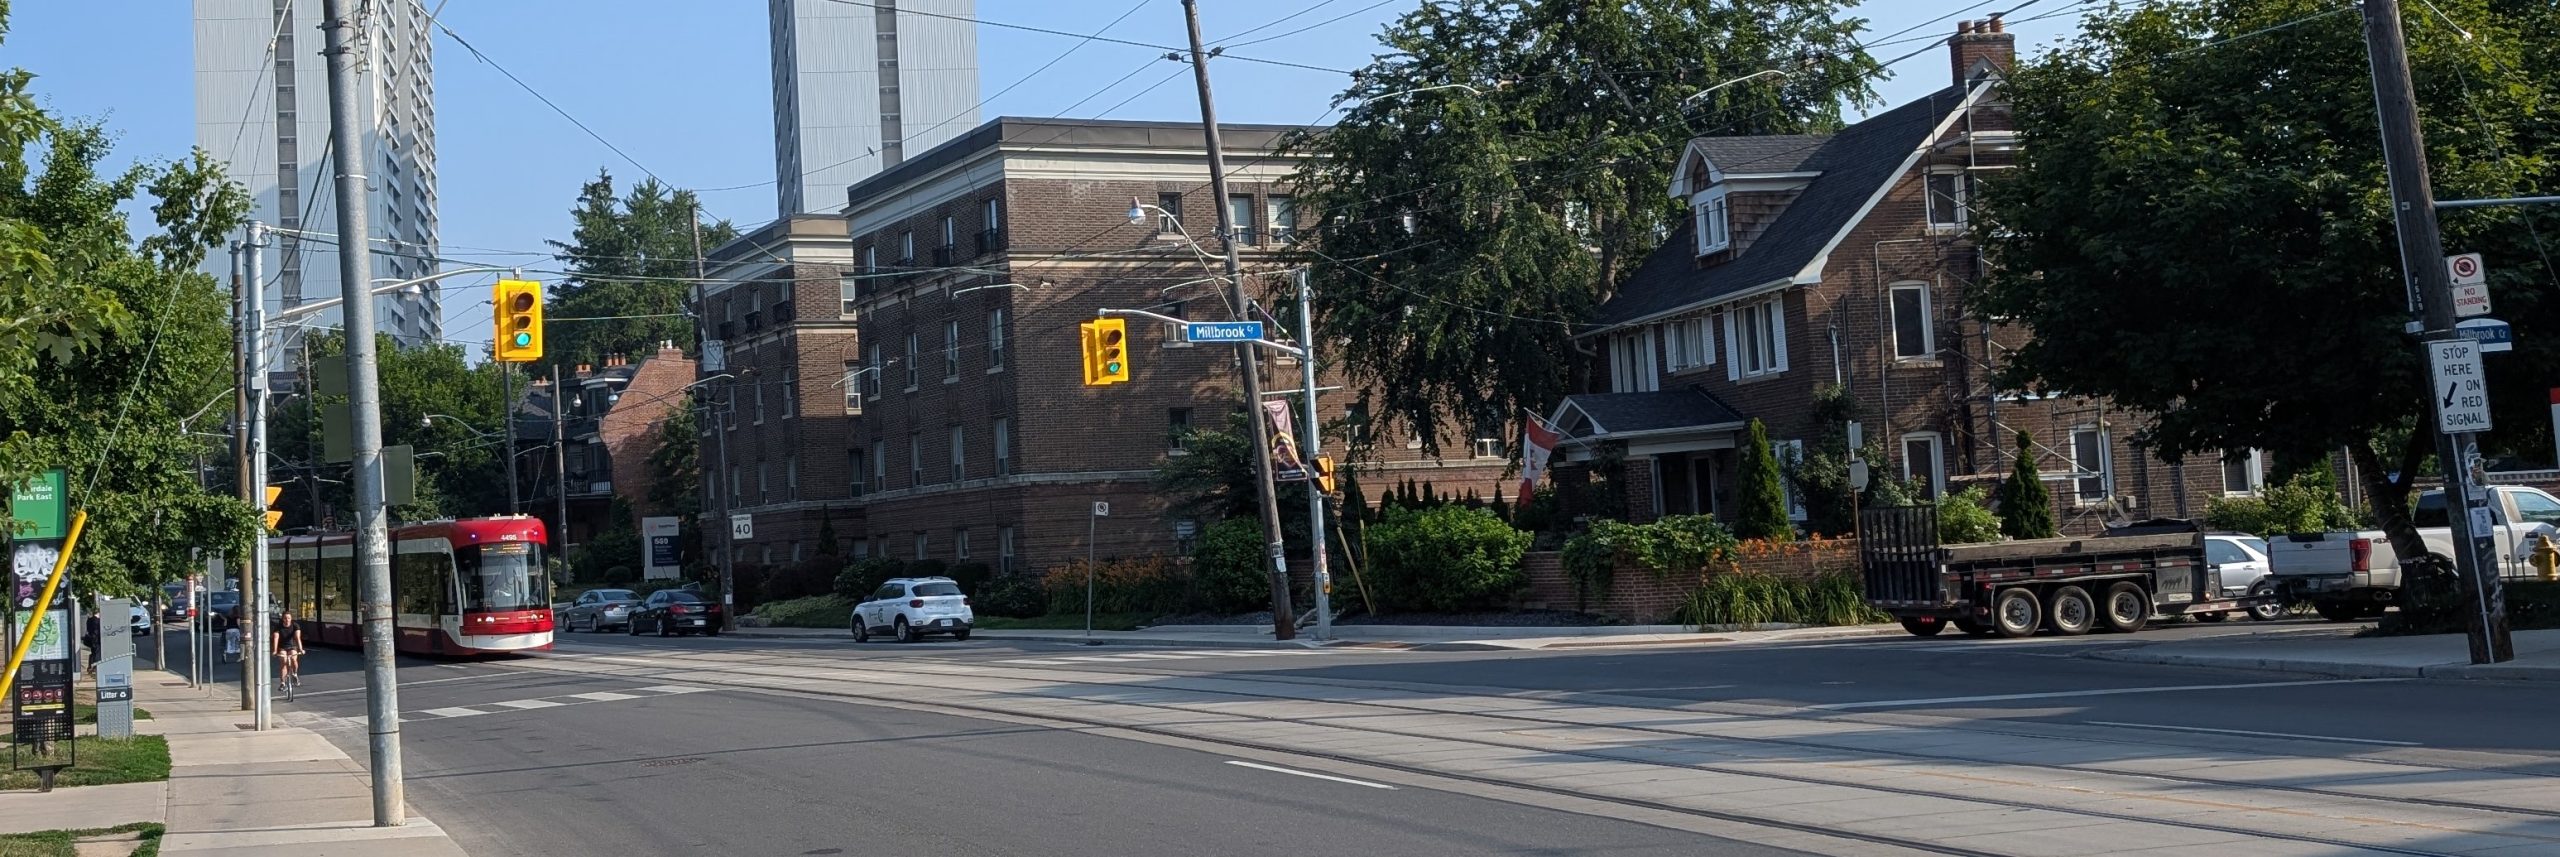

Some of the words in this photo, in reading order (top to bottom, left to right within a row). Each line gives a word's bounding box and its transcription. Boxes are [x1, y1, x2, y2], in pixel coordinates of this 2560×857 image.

[2464, 288, 2476, 297] NO
[2456, 296, 2488, 307] STANDING
[1196, 326, 1246, 339] Millbrook
[1246, 325, 1254, 334] Cr
[2459, 328, 2496, 340] Millbrook
[2498, 330, 2507, 339] Cr
[2442, 347, 2469, 360] STOP
[2443, 363, 2473, 376] HERE
[2465, 379, 2481, 391] ON
[2461, 395, 2483, 408] RED
[2446, 412, 2485, 426] SIGNAL
[36, 493, 52, 501] East
[735, 523, 750, 535] 40
[101, 691, 117, 699] Litter
